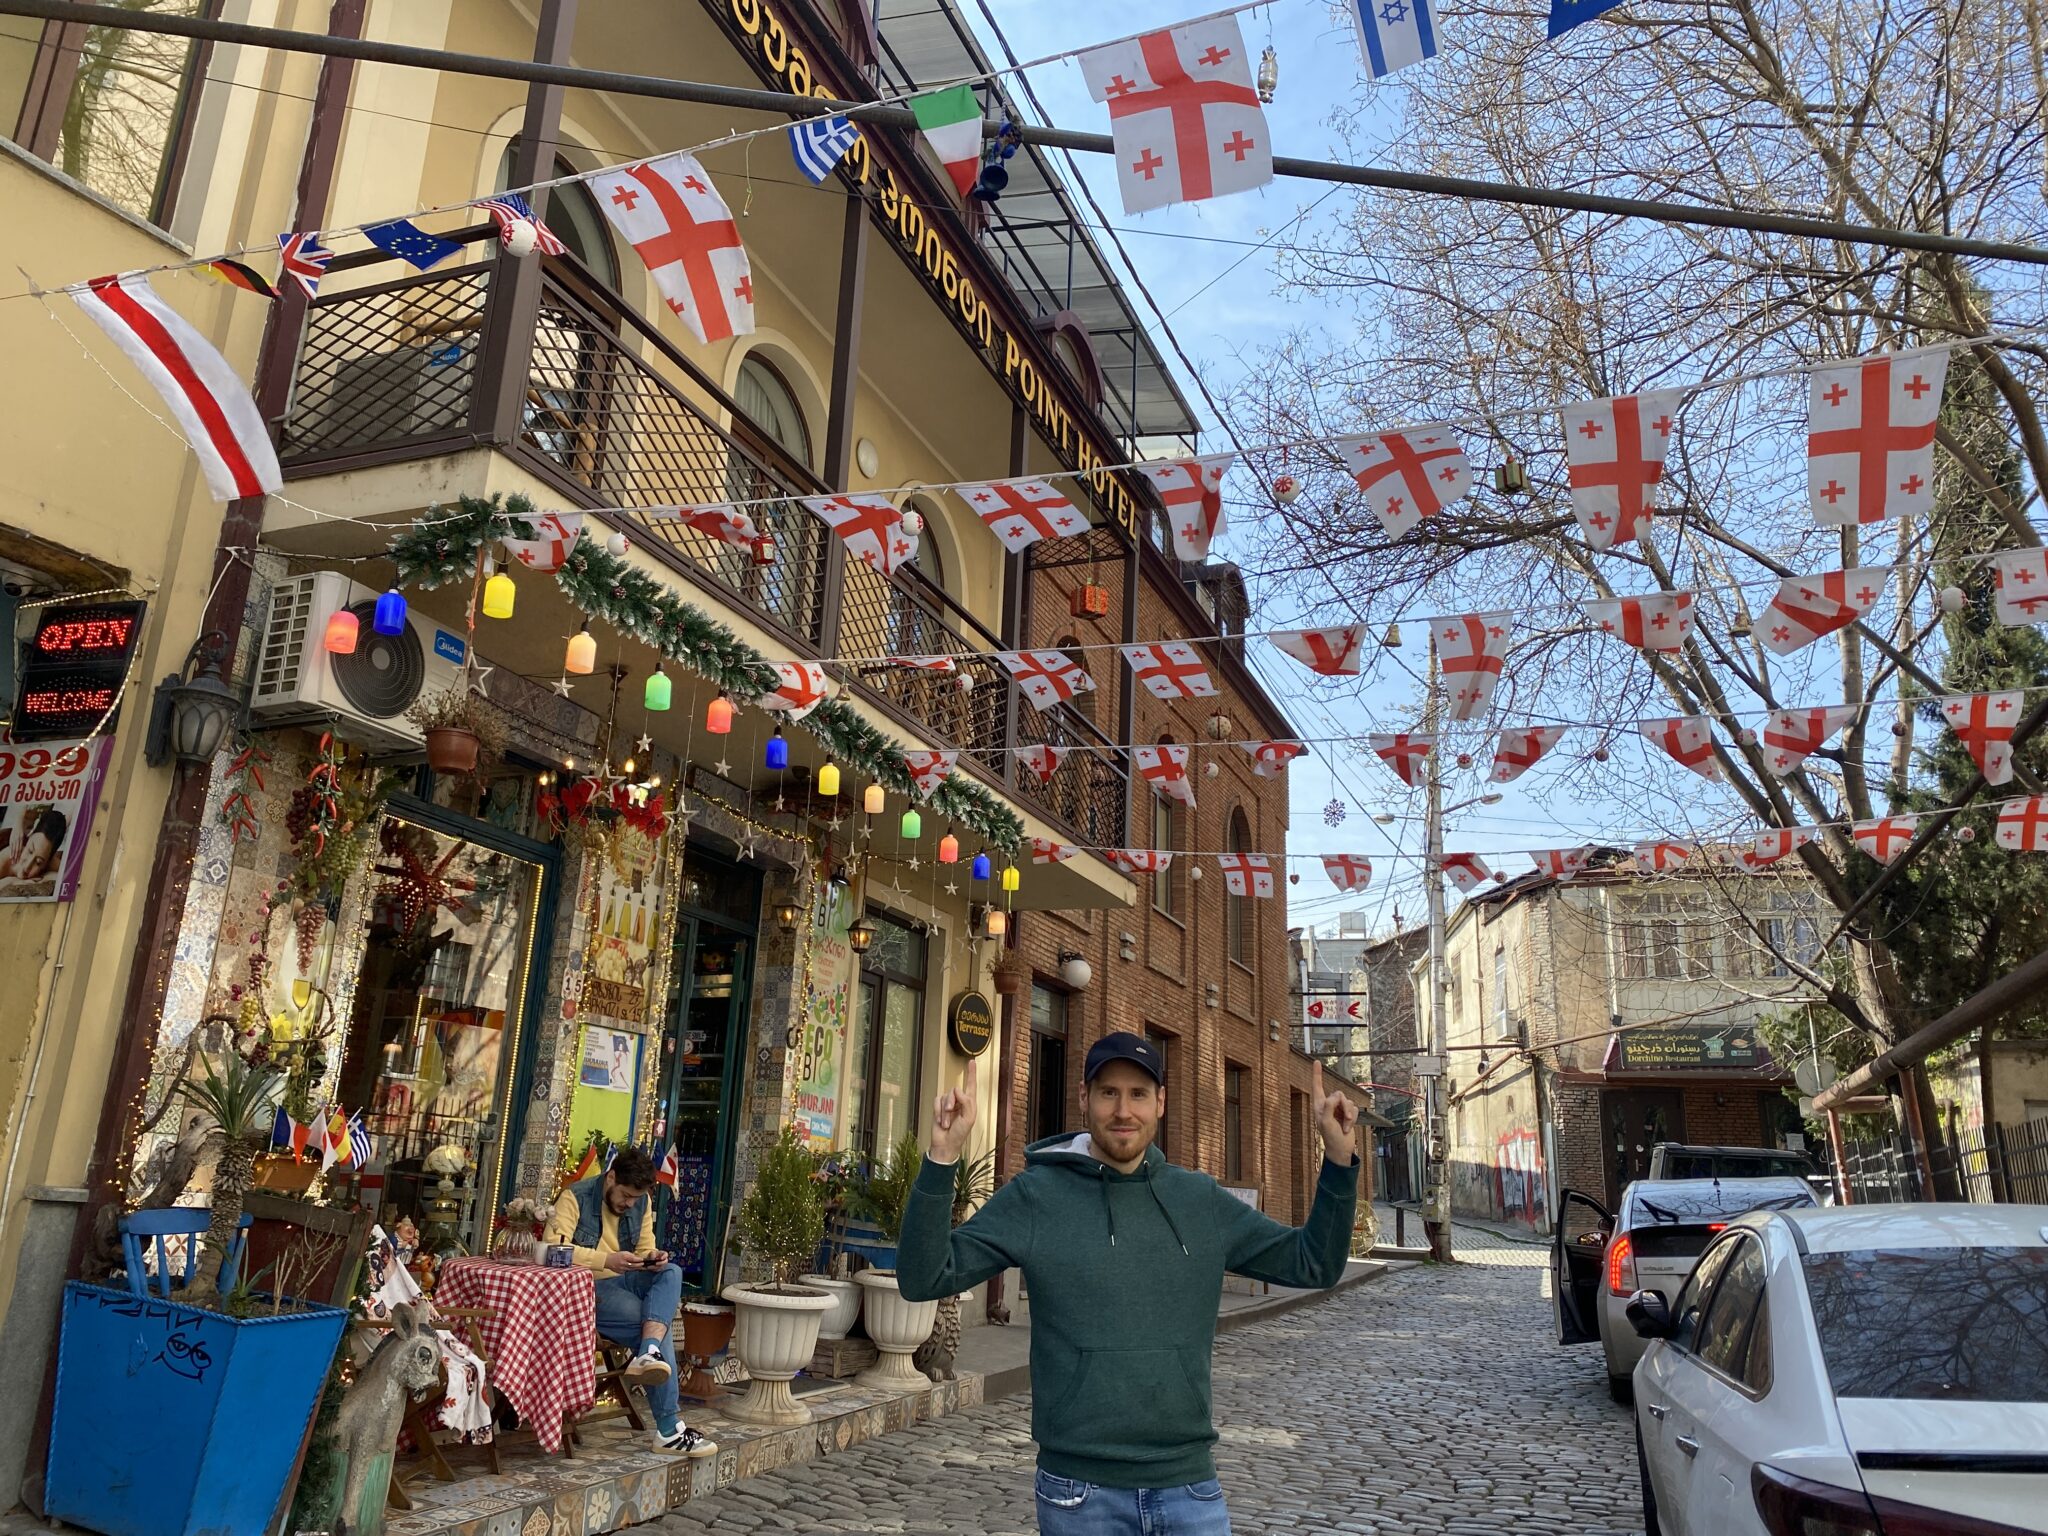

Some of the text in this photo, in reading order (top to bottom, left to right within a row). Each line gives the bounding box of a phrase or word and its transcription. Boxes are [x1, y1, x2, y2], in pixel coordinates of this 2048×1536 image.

[880, 168, 992, 349] პოინტი
[1005, 330, 1138, 541] POINT HOTEL
[40, 619, 132, 650] OPEN
[437, 637, 463, 658] Midea
[27, 690, 112, 713] WELCOME
[805, 1024, 833, 1060] ECO
[959, 1021, 989, 1037] Terrasse
[803, 1052, 832, 1086] BIO
